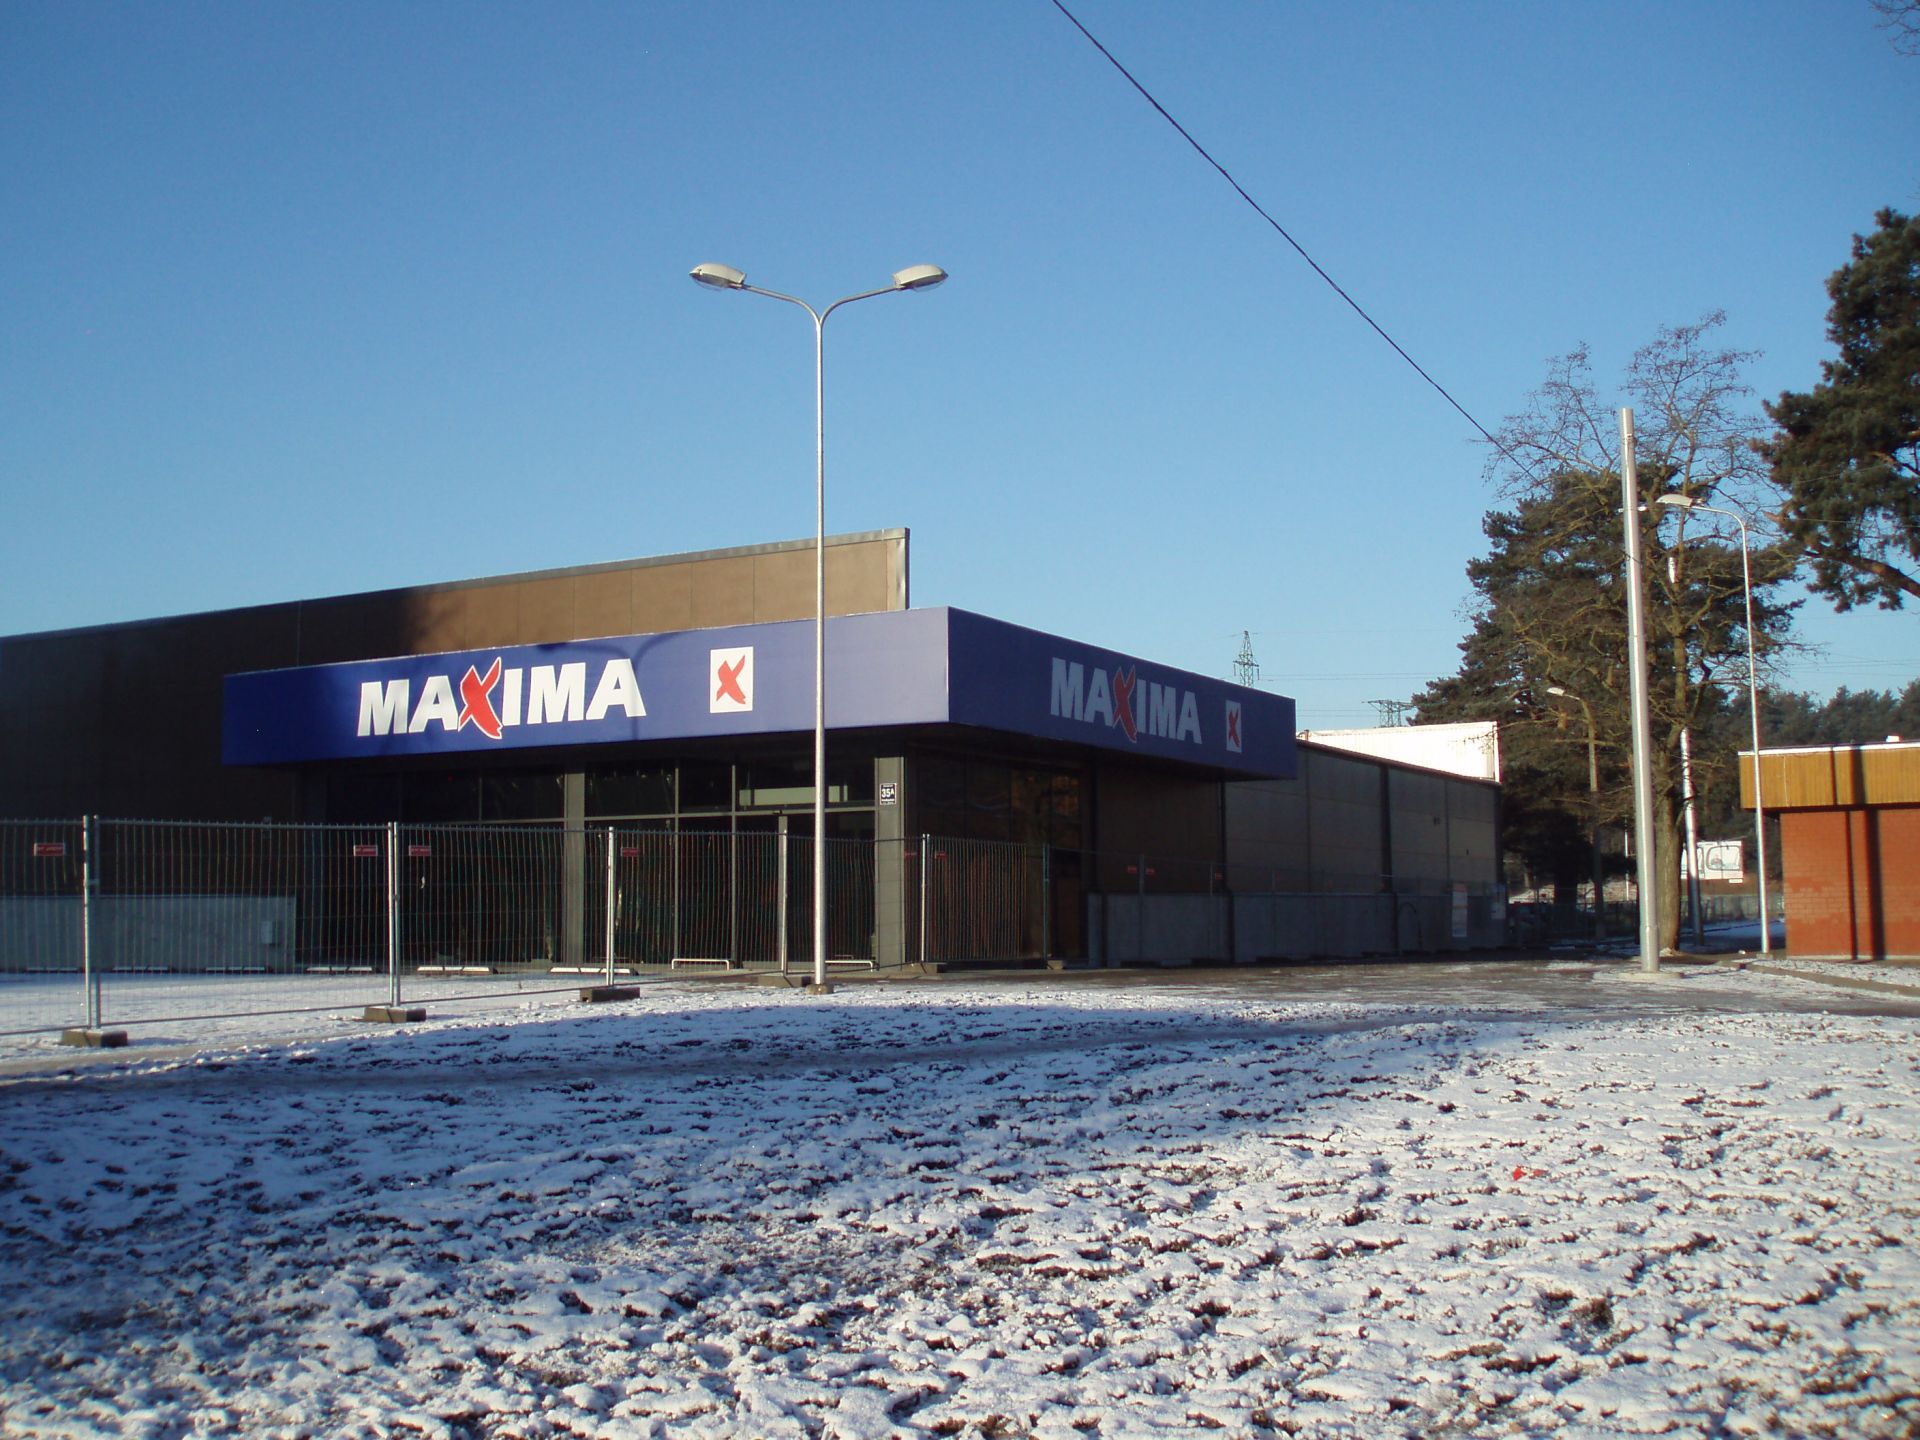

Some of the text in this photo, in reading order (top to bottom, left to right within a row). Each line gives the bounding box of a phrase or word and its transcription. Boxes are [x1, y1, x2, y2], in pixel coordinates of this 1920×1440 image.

[357, 657, 647, 739] MAXIMA
[1050, 656, 1203, 744] MAXIMA
[881, 788, 895, 798] 35A
